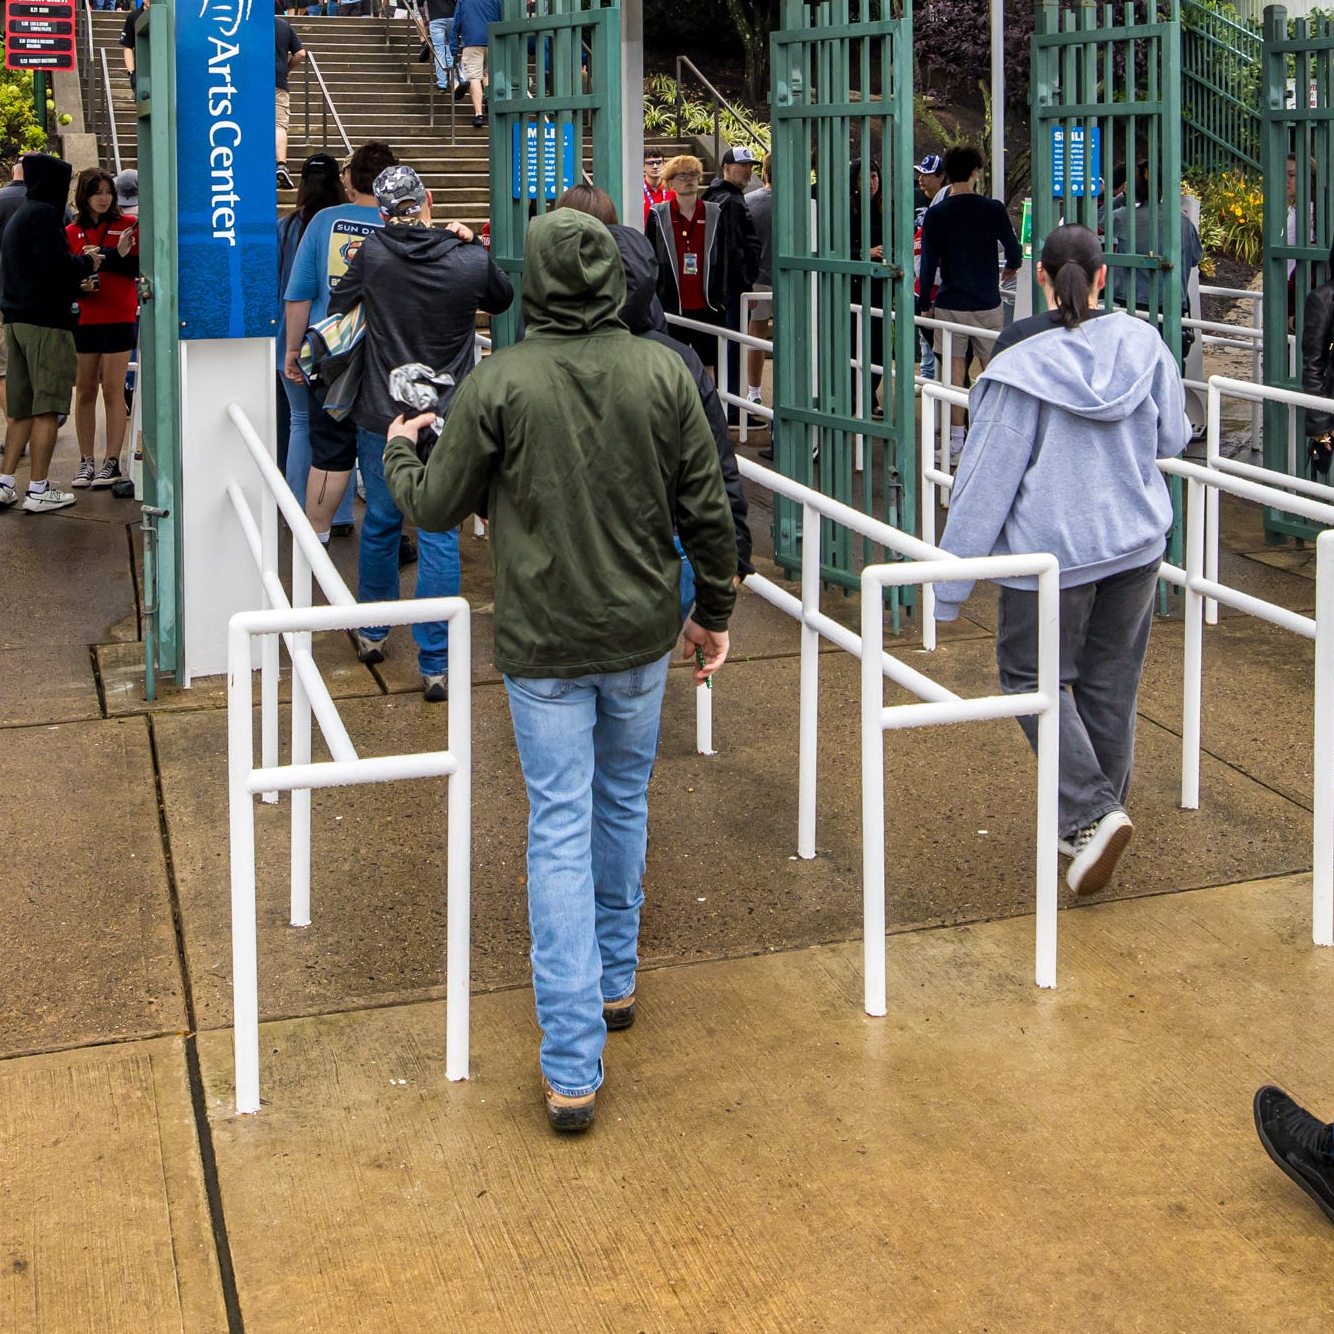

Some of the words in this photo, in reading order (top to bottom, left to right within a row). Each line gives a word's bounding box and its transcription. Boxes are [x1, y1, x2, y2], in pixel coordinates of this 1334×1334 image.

[208, 38, 238, 114] Arts
[210, 119, 242, 246] Center
[337, 224, 358, 233] SUN
